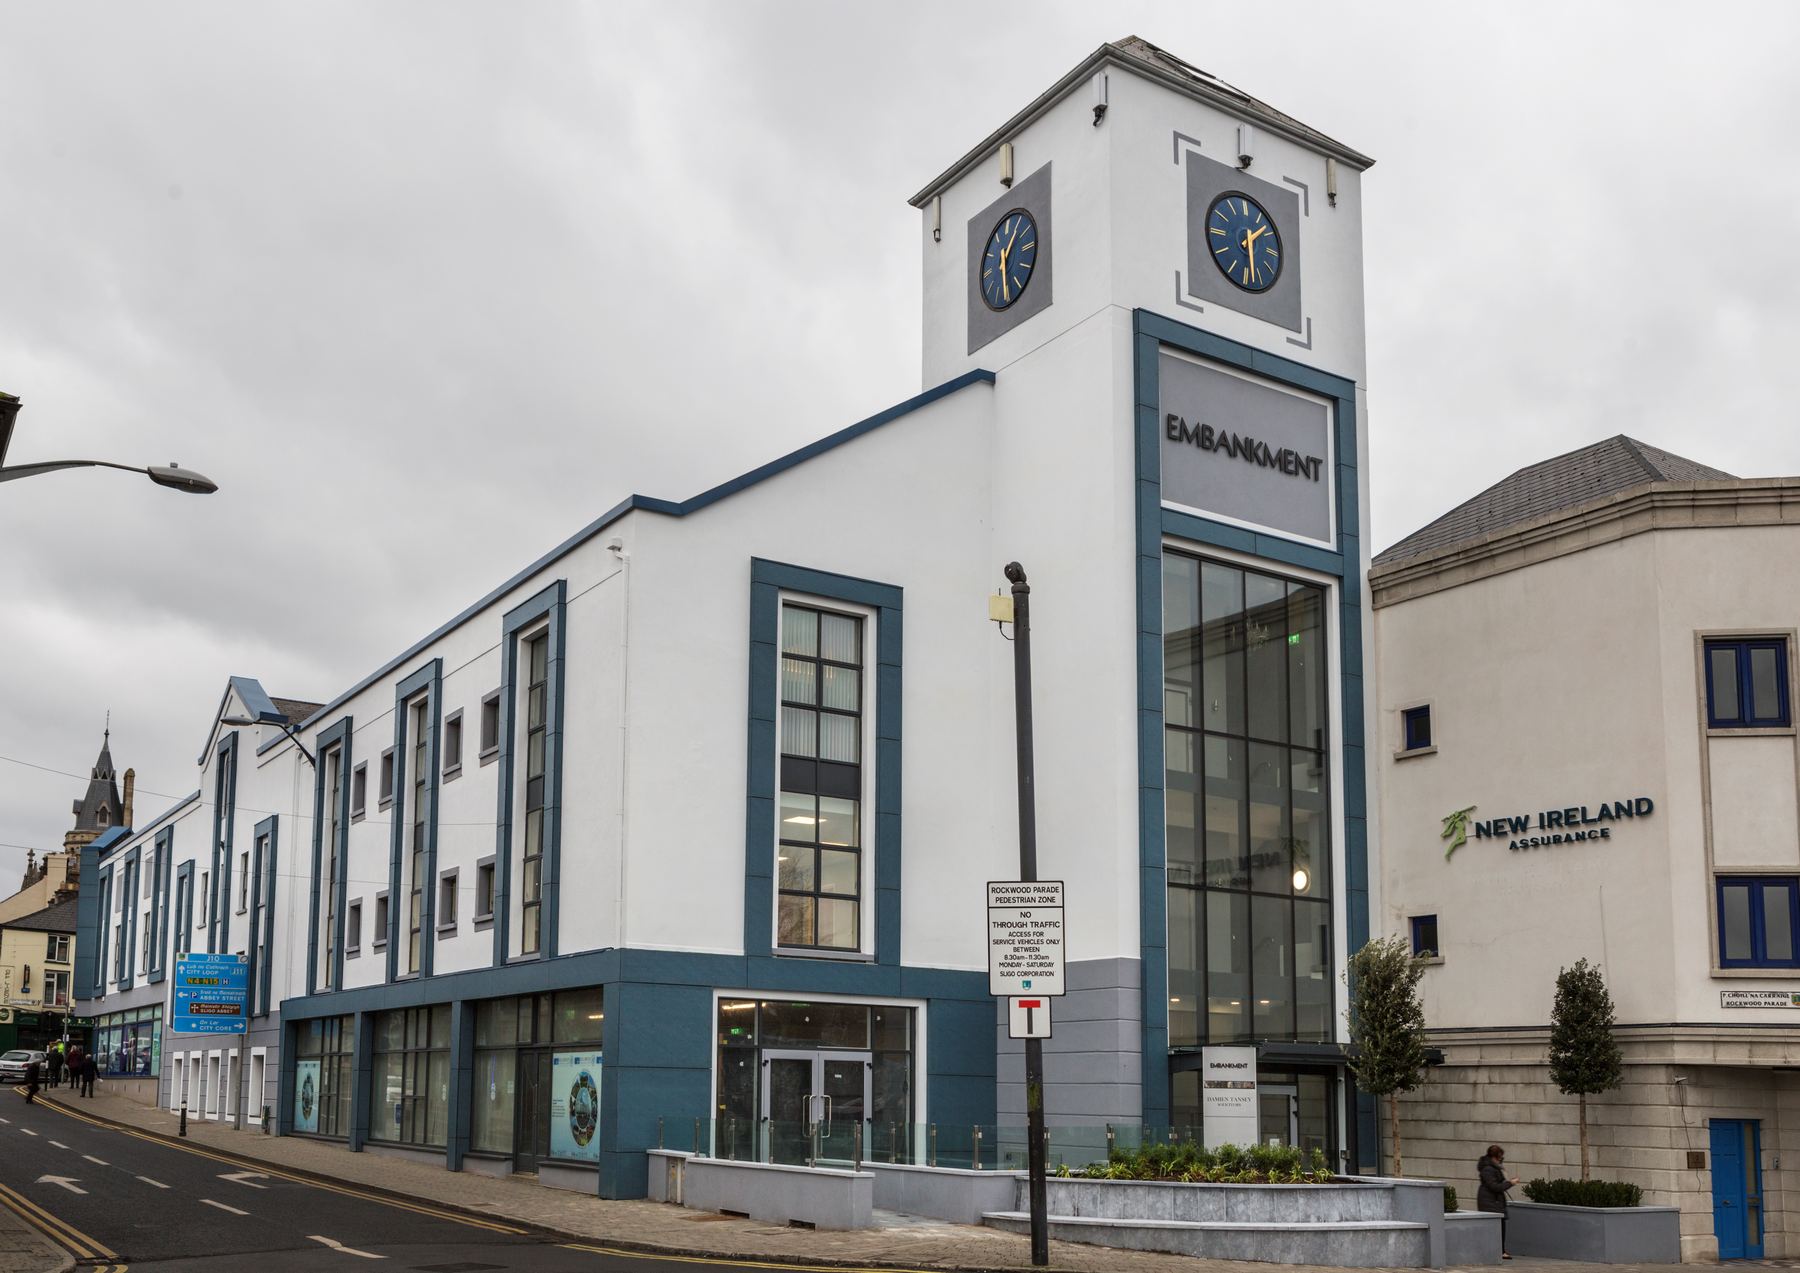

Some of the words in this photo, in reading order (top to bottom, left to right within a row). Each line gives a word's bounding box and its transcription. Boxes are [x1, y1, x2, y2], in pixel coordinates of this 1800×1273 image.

[1166, 413, 1323, 483] EMBANKMENT
[1475, 815, 1530, 838] NEW
[1538, 797, 1655, 830] IRELAND
[1509, 828, 1611, 850] ASSURANCE
[991, 886, 1032, 894] ROCKWOOD
[995, 896, 1037, 904] PEDESTRIAN
[1019, 911, 1032, 919] NO
[992, 921, 1028, 929] THROUGH
